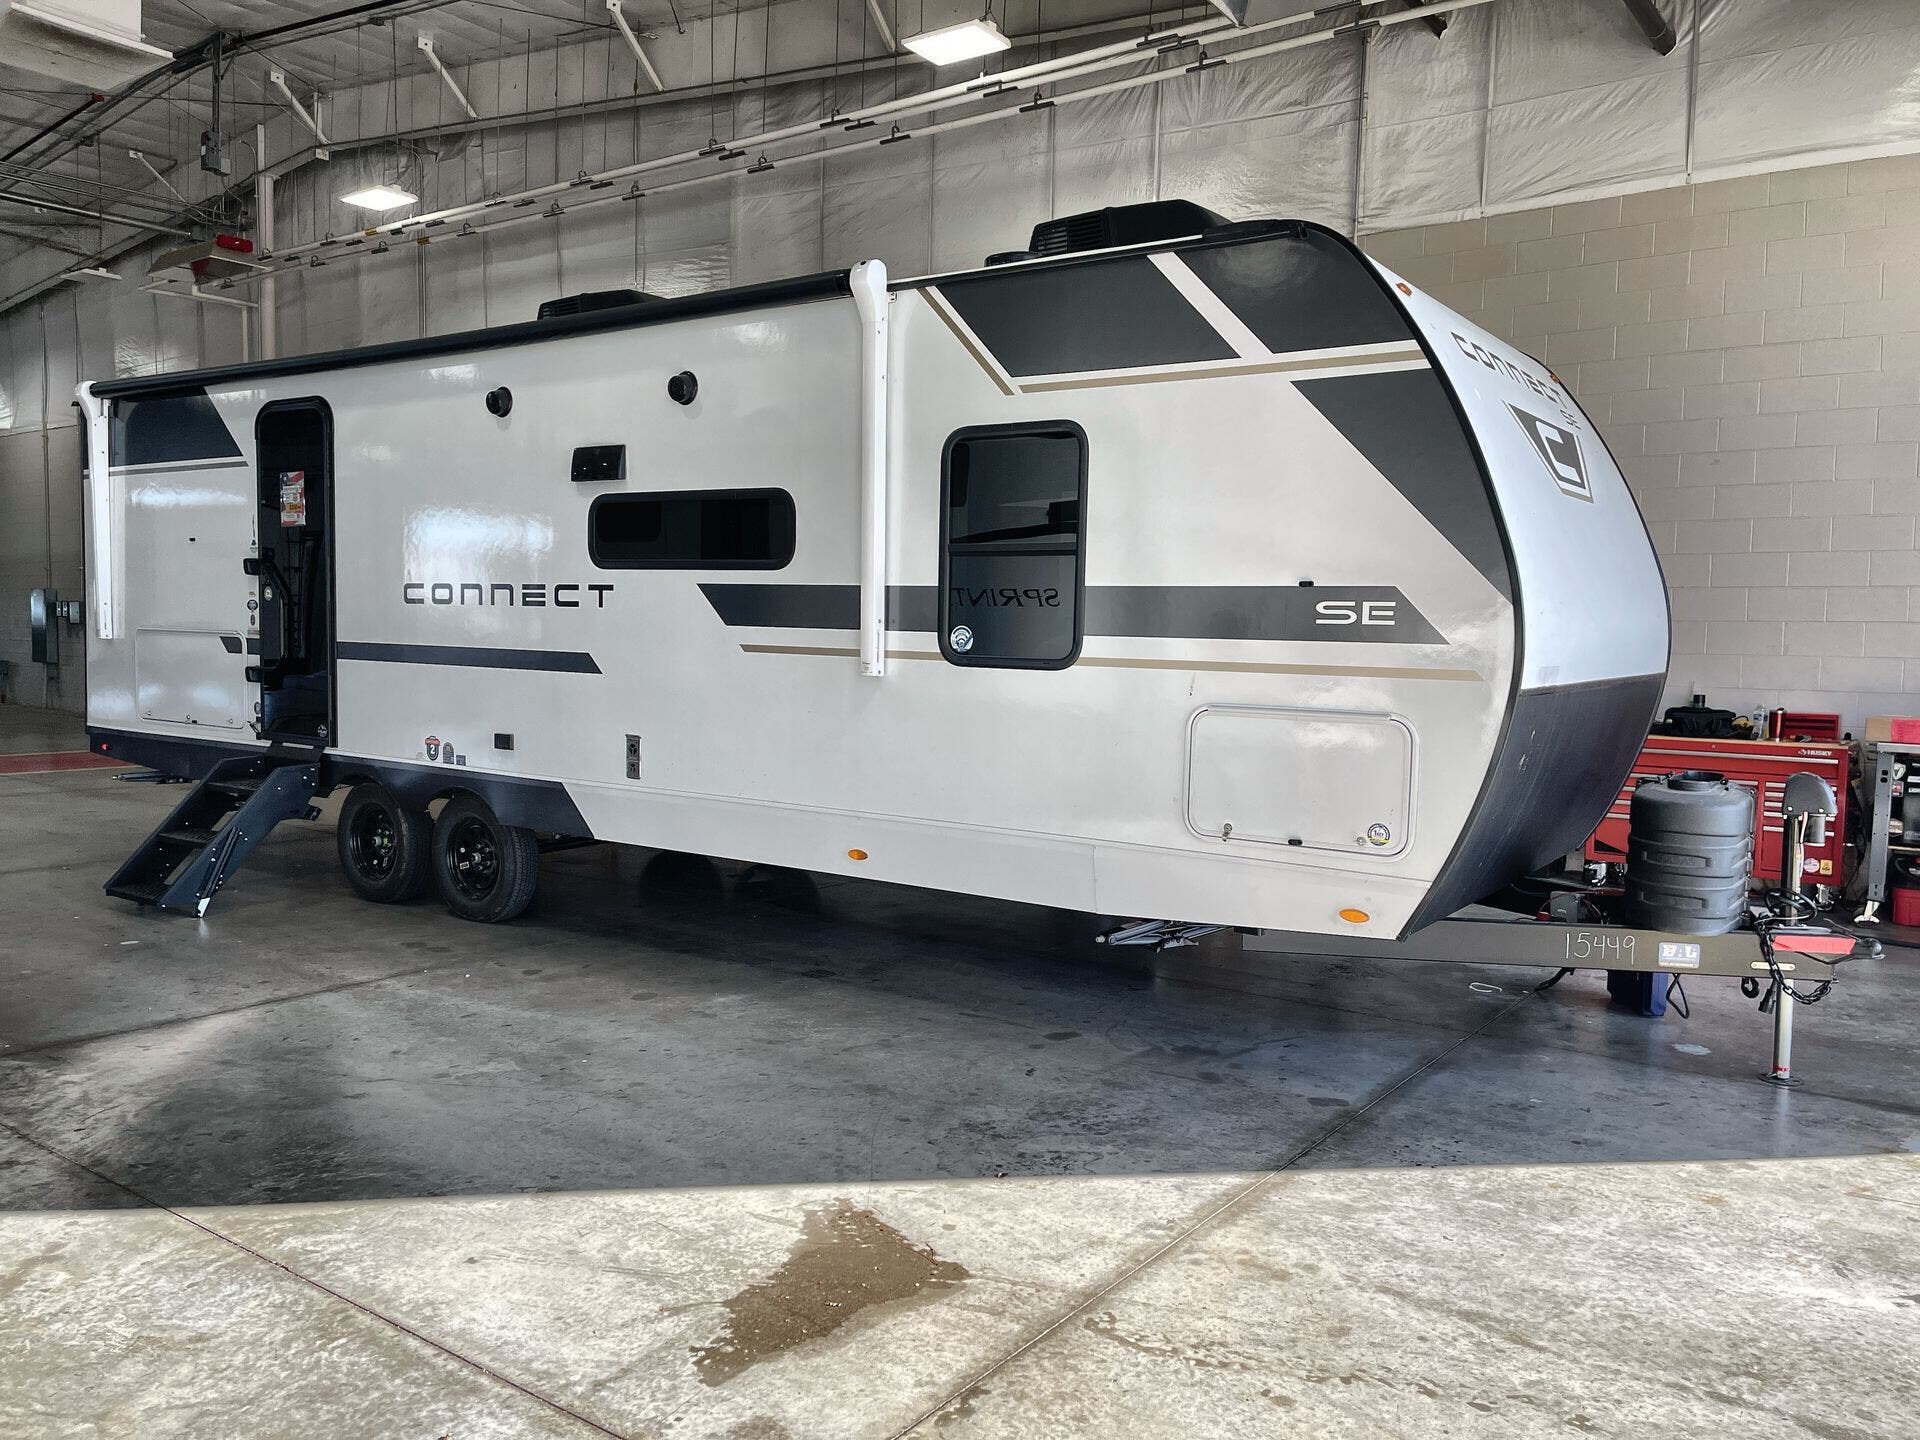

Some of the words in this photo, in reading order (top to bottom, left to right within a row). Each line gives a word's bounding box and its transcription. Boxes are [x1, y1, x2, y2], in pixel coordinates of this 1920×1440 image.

[1451, 332, 1567, 409] CONNECT
[403, 583, 614, 608] CONNECT
[1315, 601, 1396, 625] SE
[430, 744, 436, 755] 2
[1565, 932, 1636, 966] 15449
